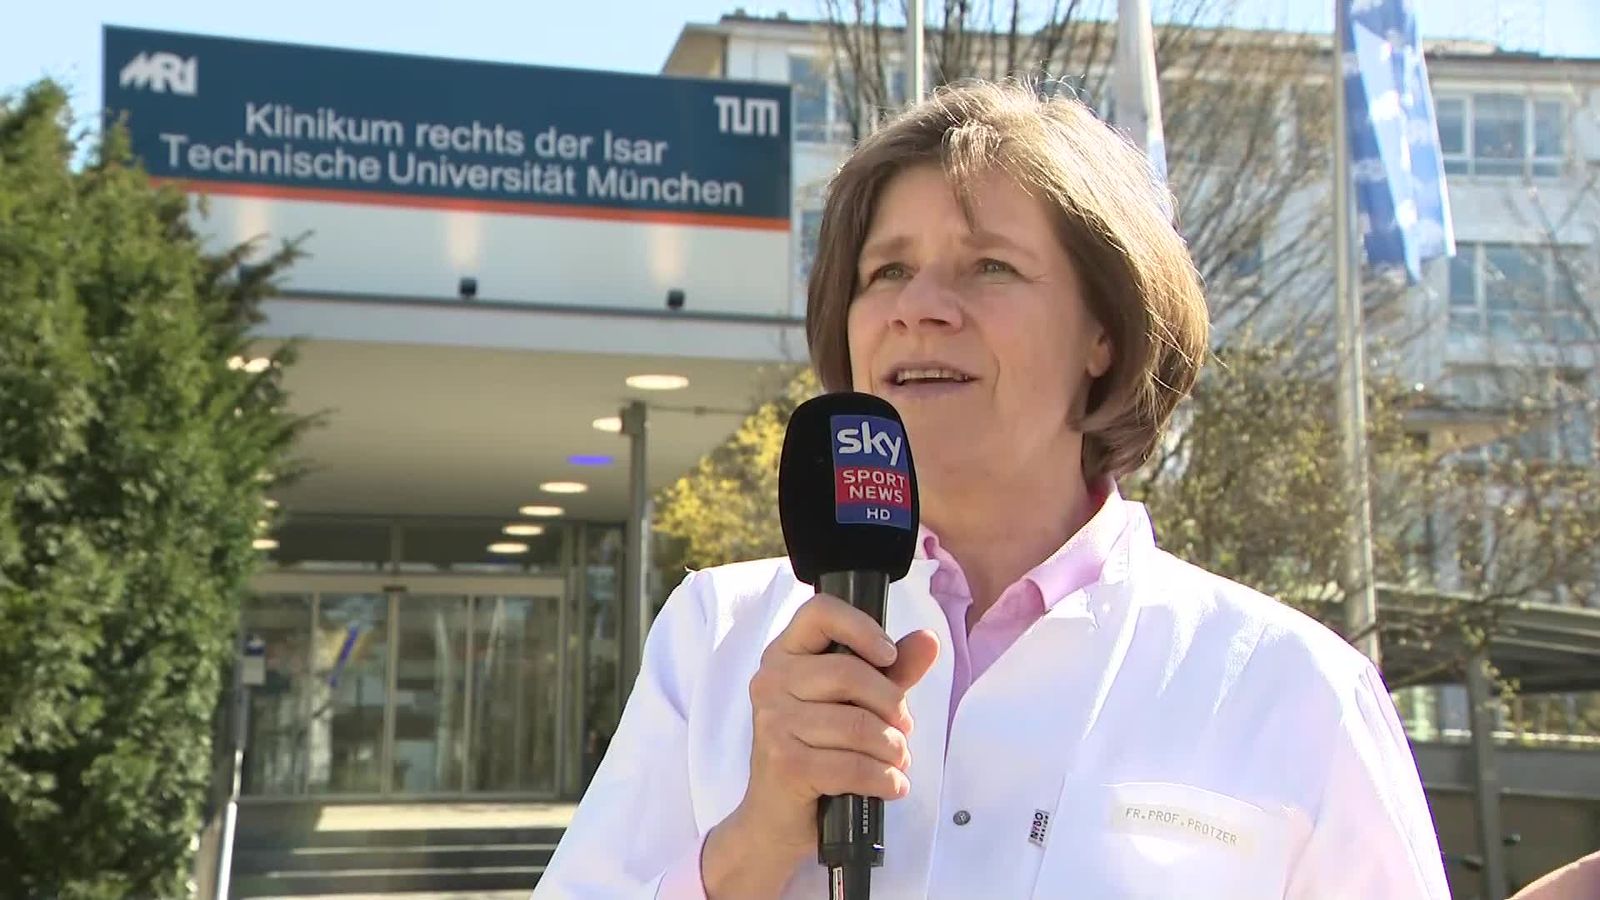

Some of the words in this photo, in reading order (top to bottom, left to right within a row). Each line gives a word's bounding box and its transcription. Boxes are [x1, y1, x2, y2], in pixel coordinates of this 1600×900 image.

[245, 102, 404, 148] Klinikum
[415, 119, 525, 156] rechts
[534, 126, 593, 160] der
[603, 130, 668, 165] Isar
[714, 95, 780, 137] TUM
[160, 133, 381, 183] Technische
[388, 151, 577, 196] Universität
[586, 165, 744, 207] München
[836, 421, 902, 467] sky
[842, 469, 905, 489] SPORT
[849, 485, 904, 504] NEWS
[866, 507, 891, 520] HD
